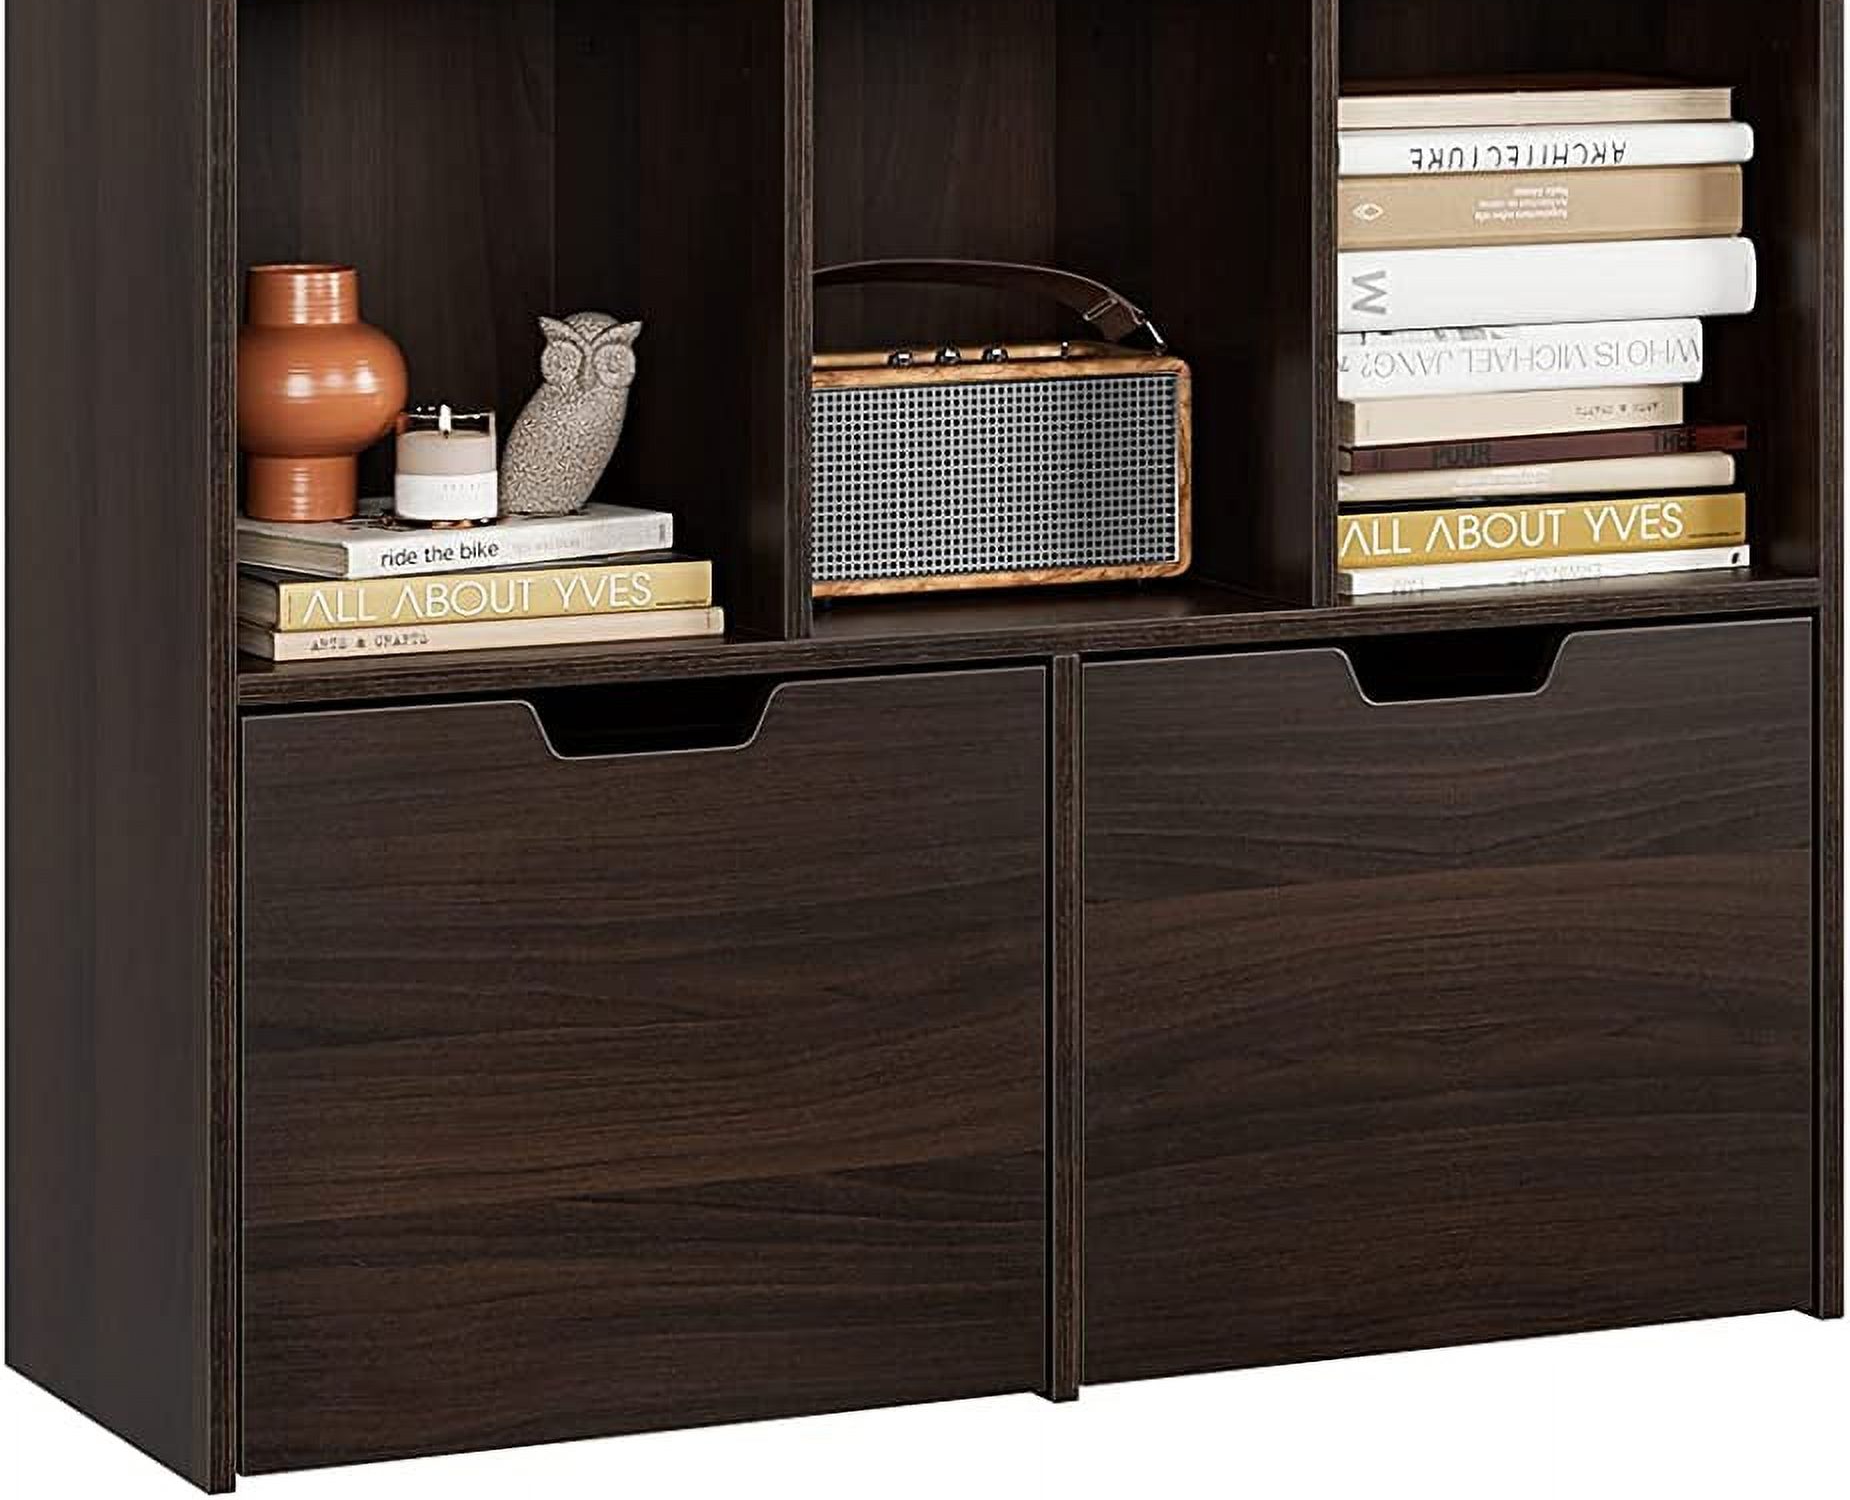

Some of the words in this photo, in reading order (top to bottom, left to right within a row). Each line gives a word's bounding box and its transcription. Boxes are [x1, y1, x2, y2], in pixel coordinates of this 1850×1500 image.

[1410, 141, 1627, 171] ARCHITECTURE
[1360, 346, 1455, 380] JANG?
[1466, 340, 1589, 374] MICHAEL
[1597, 340, 1622, 367] IS
[1625, 335, 1701, 364] WHO
[1340, 517, 1412, 558] ALL
[1424, 509, 1569, 553] ABOUT
[1582, 501, 1684, 544] YVES
[379, 545, 418, 569] ride
[422, 543, 456, 565] the
[460, 539, 500, 561] bike
[301, 589, 378, 625] ALL
[390, 579, 532, 620] ABOUT
[551, 572, 653, 609] YVES
